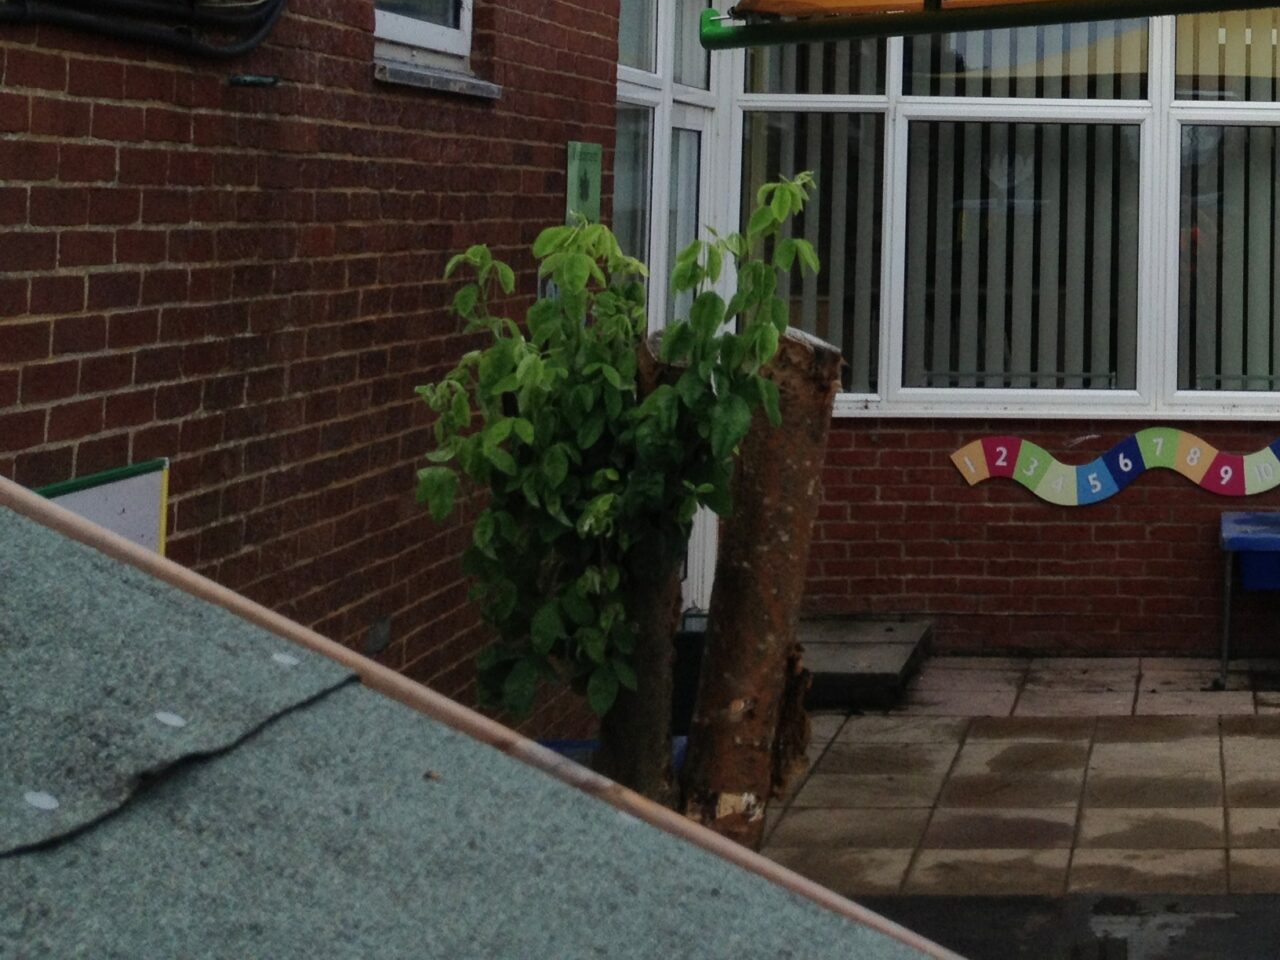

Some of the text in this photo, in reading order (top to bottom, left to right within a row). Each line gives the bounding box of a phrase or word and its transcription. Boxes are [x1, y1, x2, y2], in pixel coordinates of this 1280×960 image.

[995, 446, 1008, 466] 2
[1023, 457, 1040, 476] 3
[1088, 472, 1102, 493] 5
[1118, 452, 1133, 472] 6
[1153, 437, 1164, 456] 7
[1186, 447, 1201, 466] 8
[1220, 465, 1233, 485] 9
